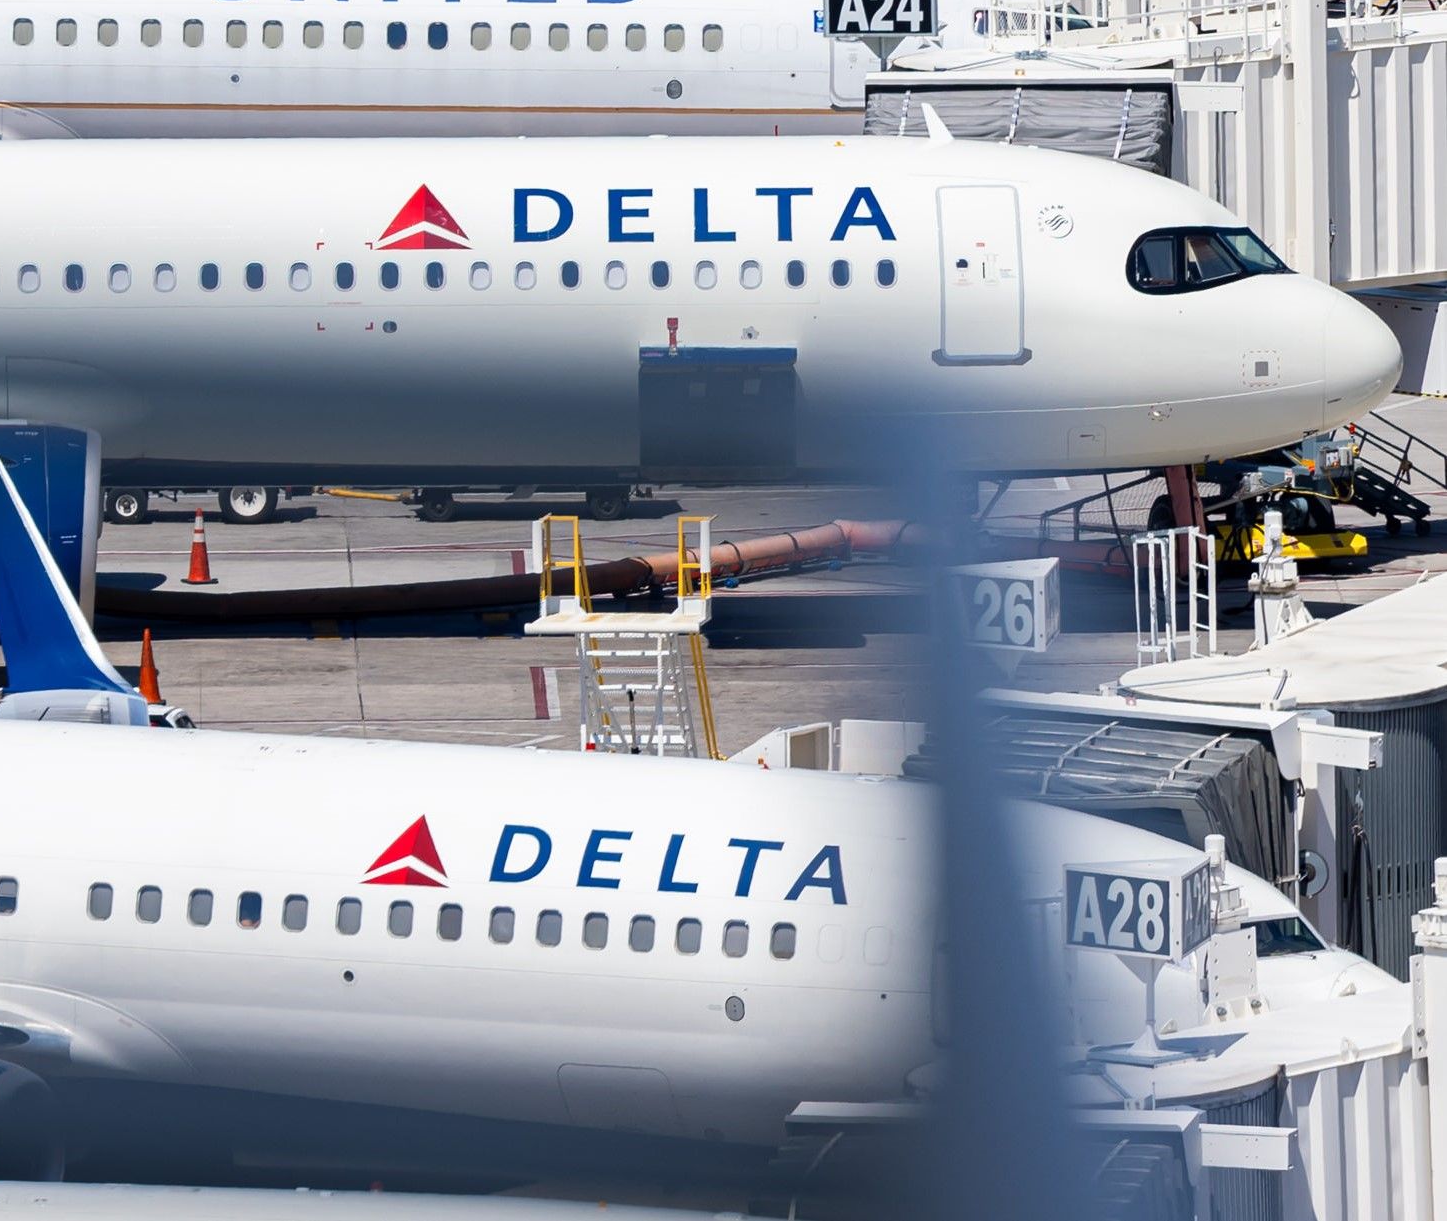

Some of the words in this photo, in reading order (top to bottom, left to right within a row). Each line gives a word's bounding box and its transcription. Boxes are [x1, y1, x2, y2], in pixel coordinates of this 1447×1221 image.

[514, 187, 895, 243] DELTA
[973, 579, 1034, 645] 26
[490, 825, 848, 906] DELTA
[1073, 875, 1165, 953] A28
